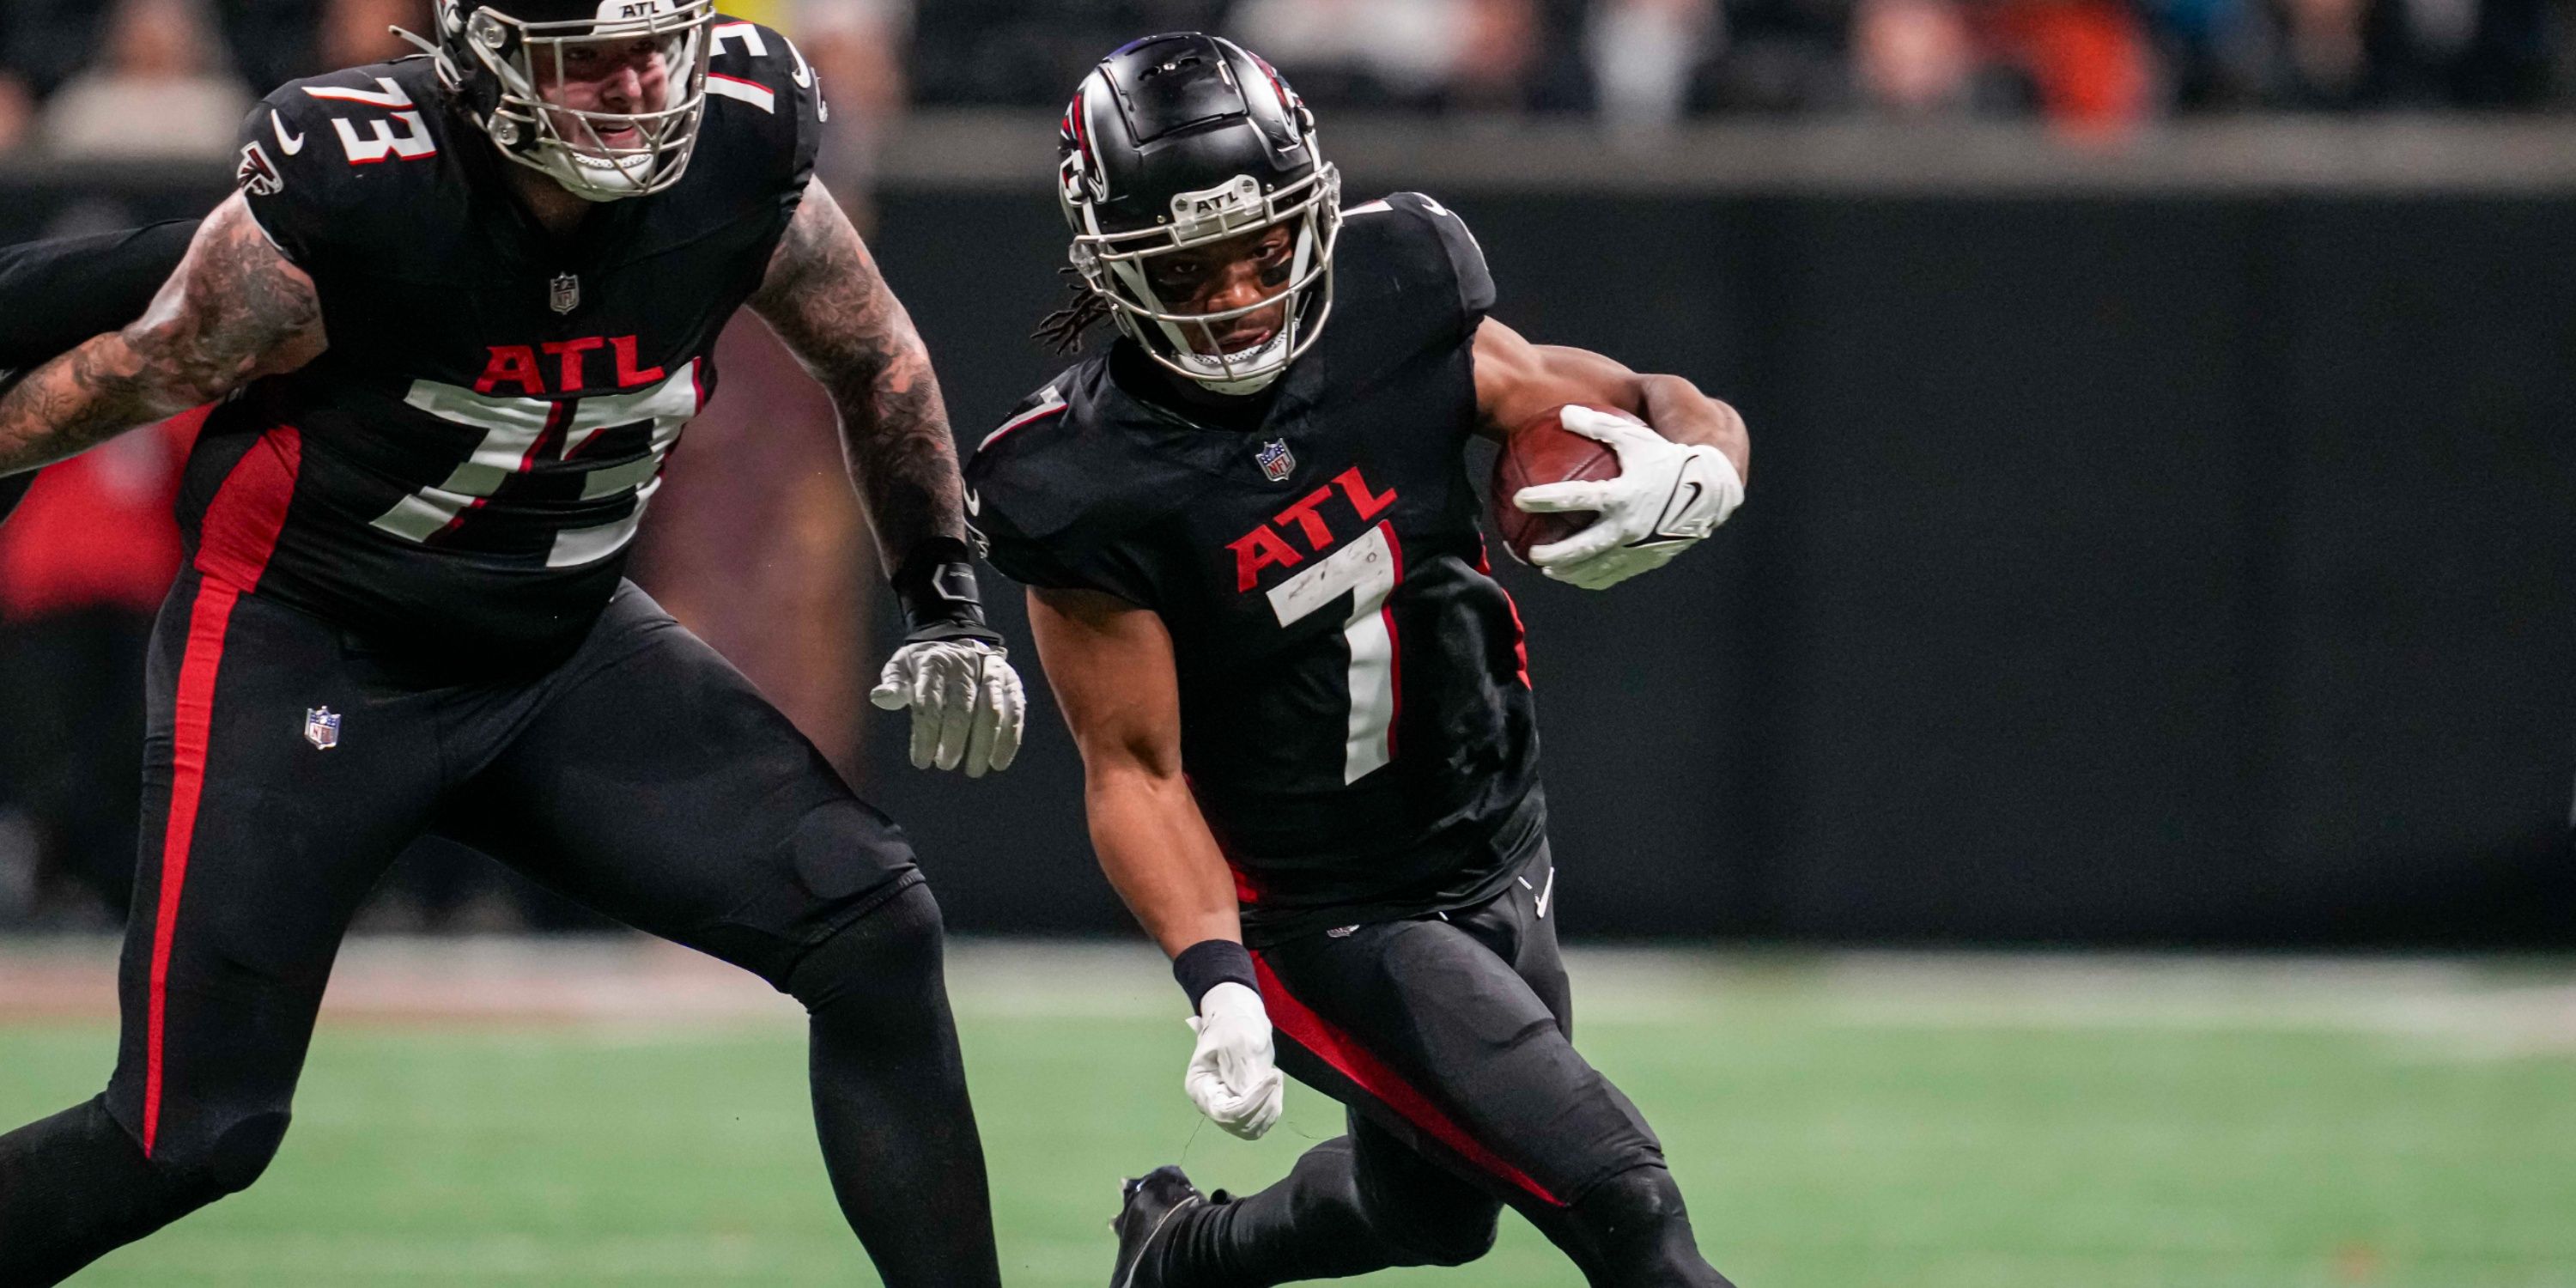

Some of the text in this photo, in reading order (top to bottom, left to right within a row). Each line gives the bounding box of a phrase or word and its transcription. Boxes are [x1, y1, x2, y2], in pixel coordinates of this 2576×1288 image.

[619, 1, 659, 18] ATL
[301, 77, 438, 166] 73
[1194, 191, 1238, 213] ATL
[473, 335, 665, 394] ATL
[368, 356, 705, 568] 73
[1224, 466, 1398, 593] ATL
[1266, 519, 1404, 786] 7
